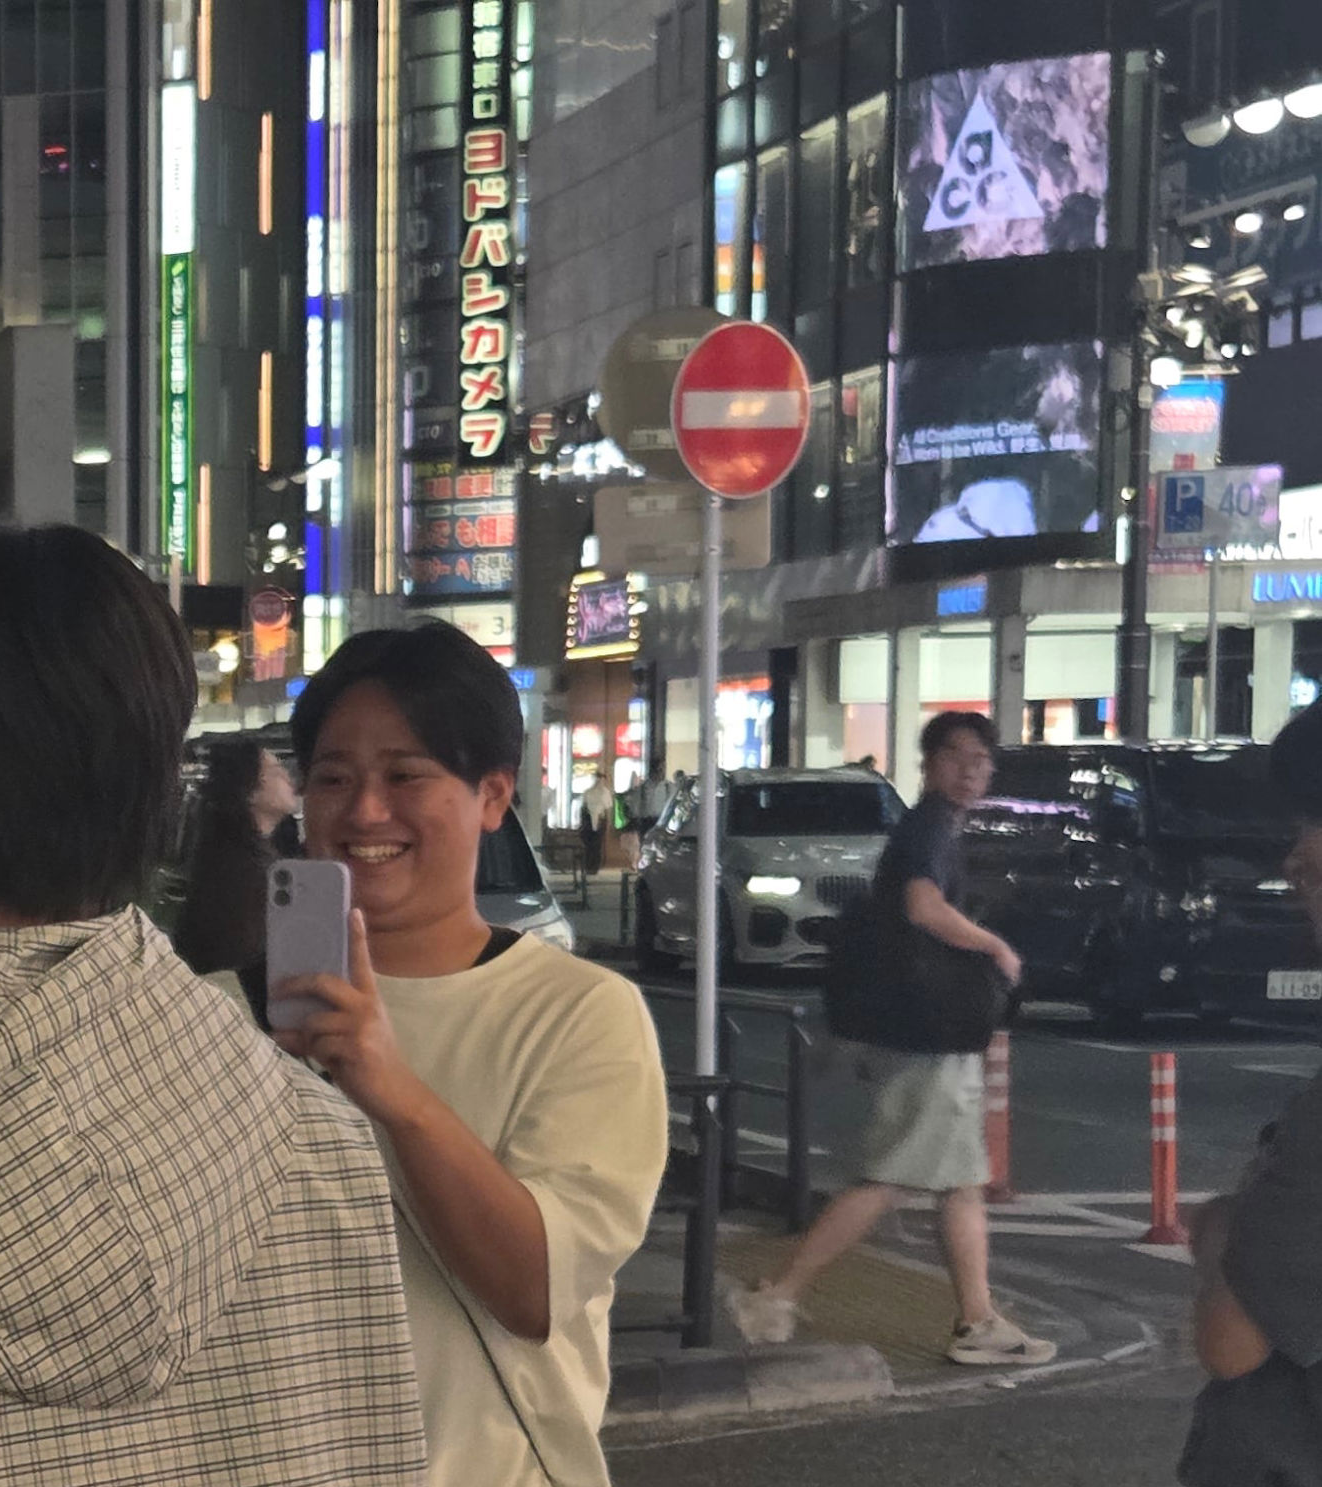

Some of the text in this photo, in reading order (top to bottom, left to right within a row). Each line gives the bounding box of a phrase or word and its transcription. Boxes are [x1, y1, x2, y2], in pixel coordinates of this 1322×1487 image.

[459, 128, 512, 458] ヨドバシカメラ
